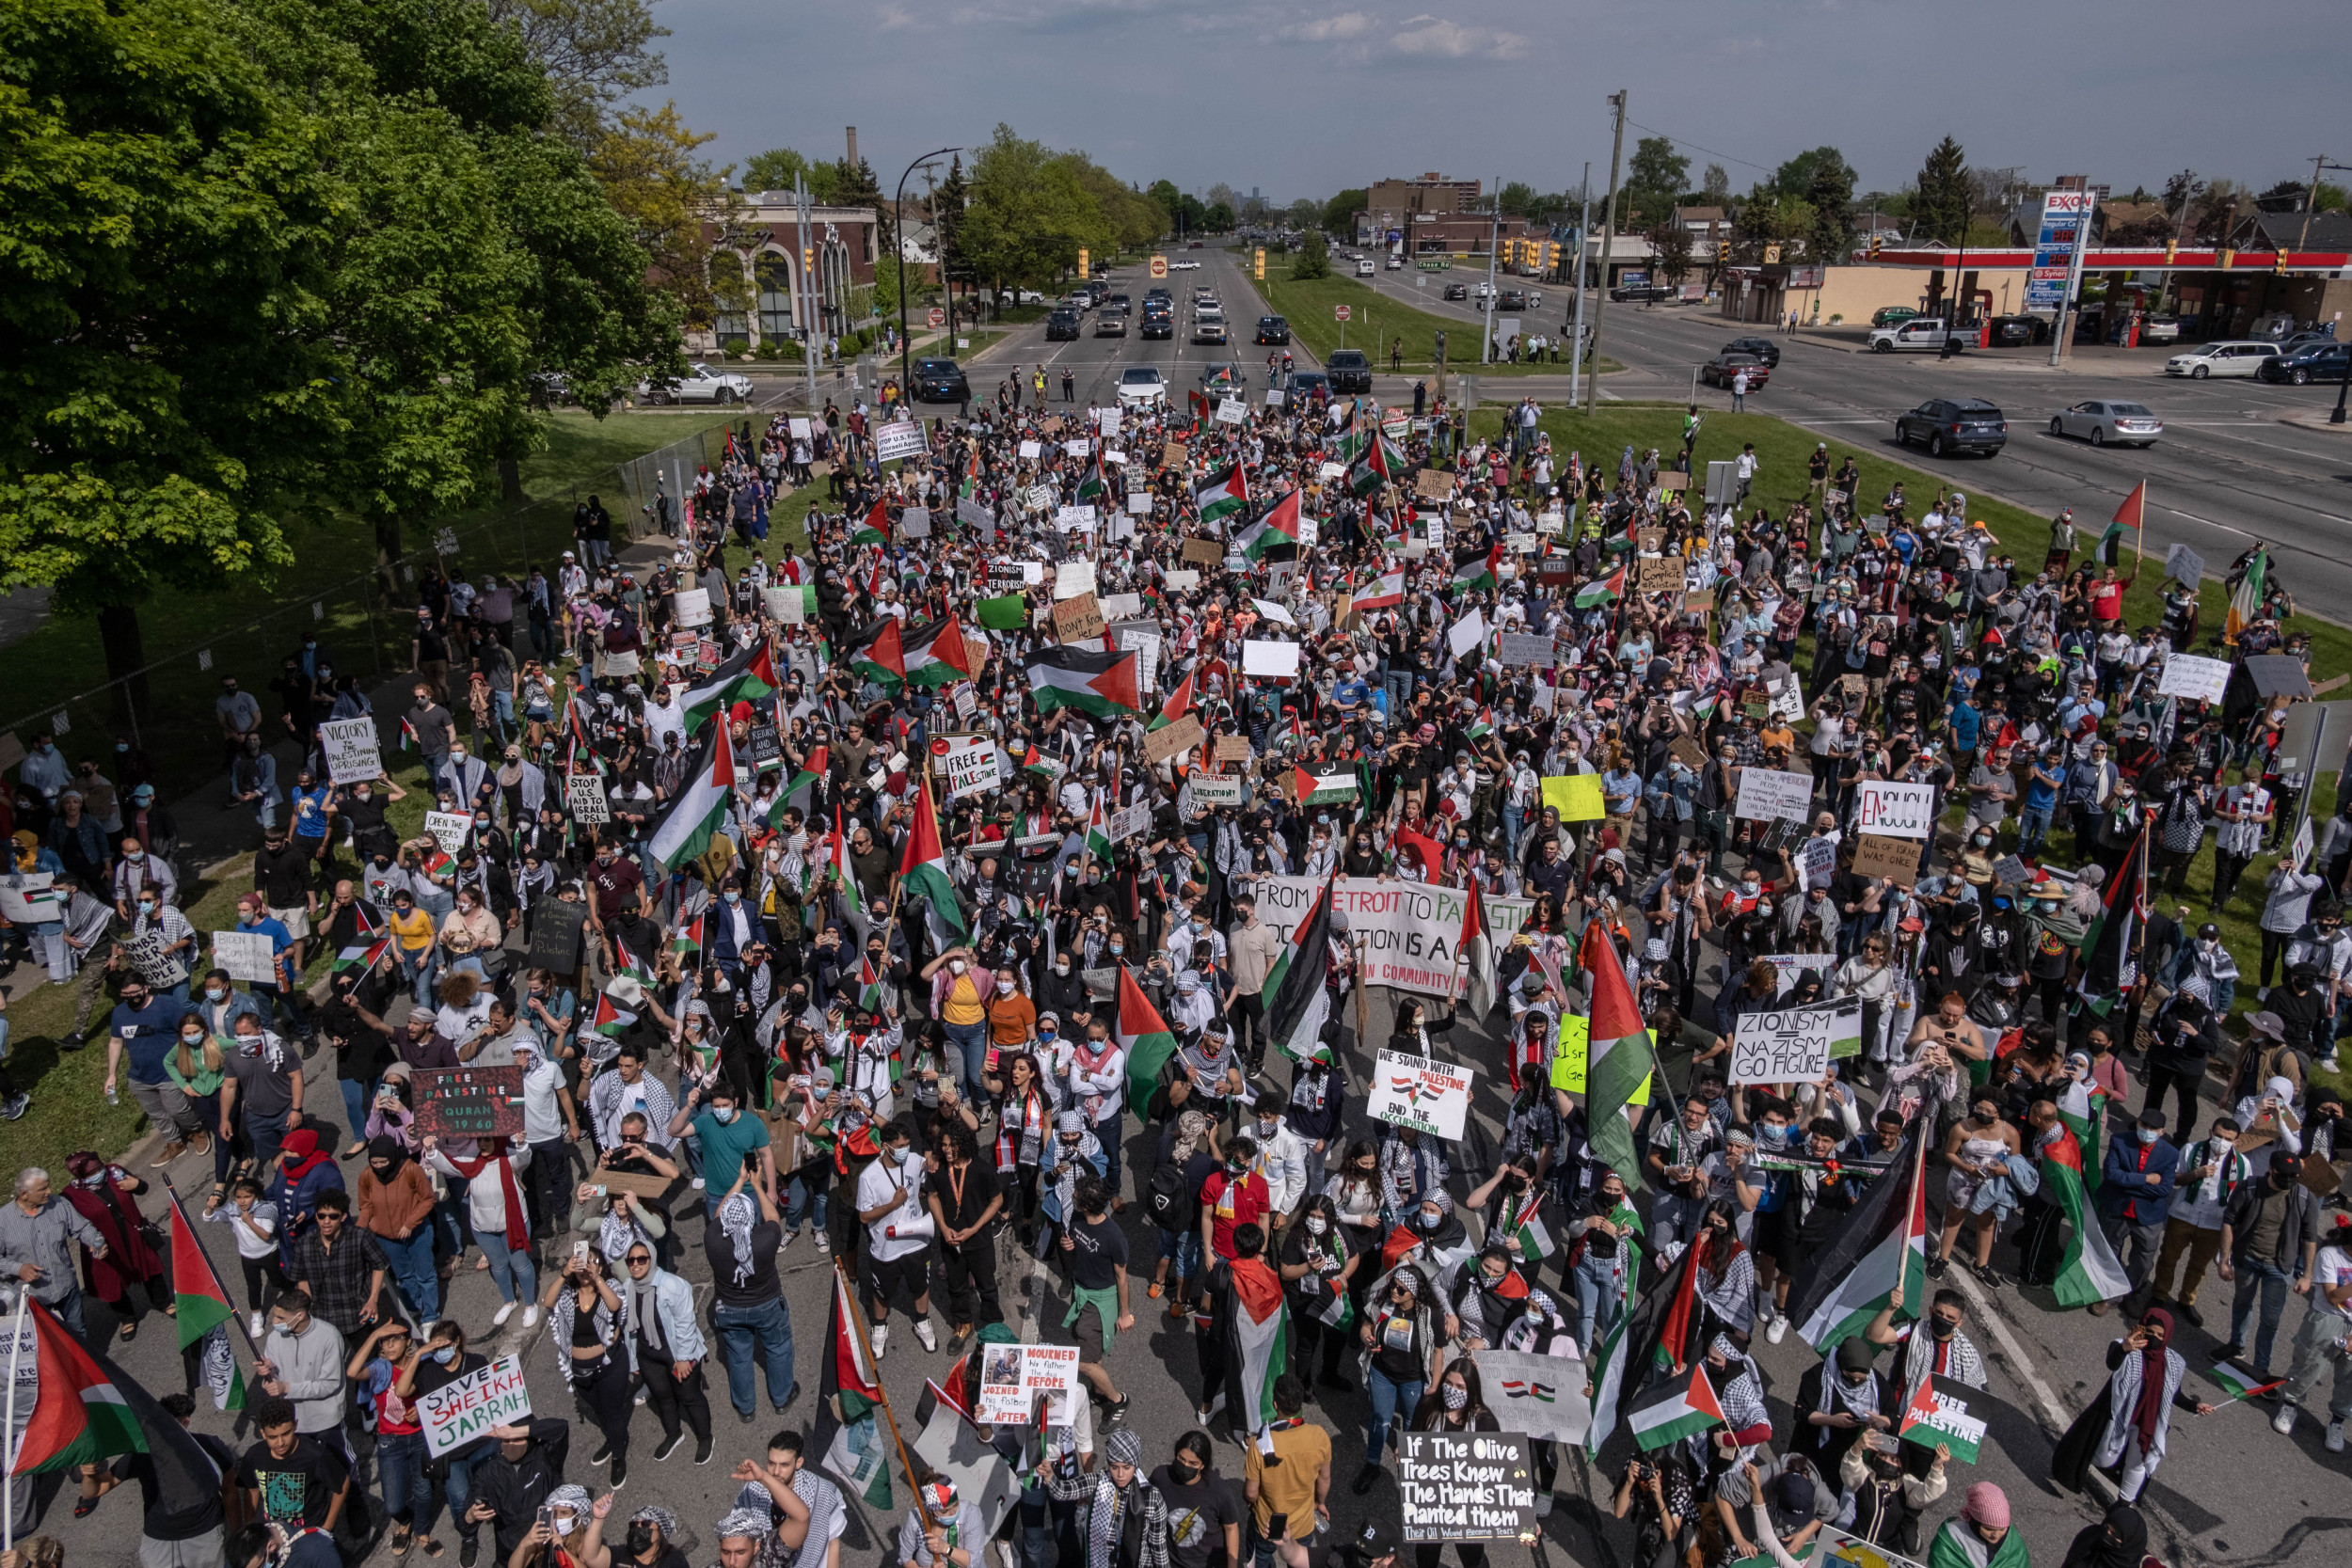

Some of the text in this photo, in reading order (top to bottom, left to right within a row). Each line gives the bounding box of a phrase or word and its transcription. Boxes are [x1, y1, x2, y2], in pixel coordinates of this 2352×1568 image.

[1429, 471, 1443, 480] LONG
[1418, 484, 1451, 497] PALESTINE
[1066, 507, 1088, 516] SAVE
[988, 564, 1023, 575] ZIONISM
[1545, 562, 1565, 571] FREE
[1642, 568, 1680, 581] Complicit
[987, 579, 1025, 590] TERRORISM
[1642, 580, 1680, 590] #Palestine
[773, 591, 791, 600] END
[1059, 617, 1083, 637] DON'T
[1745, 693, 1770, 705] FREE
[325, 722, 368, 741] VICTORY
[752, 726, 776, 740] RETURN
[755, 739, 771, 750] AND
[752, 747, 781, 760] LIBERATE
[949, 751, 977, 773] FREE
[1320, 762, 1337, 776] لن
[951, 768, 997, 791] PALESTINE
[1192, 773, 1233, 782] RESISTANCE
[1748, 770, 1762, 781] We
[1764, 771, 1776, 782] the
[570, 778, 597, 788] STOP
[1759, 781, 1782, 791] PEOPLE
[578, 788, 596, 797] U.S.
[1192, 787, 1236, 799] LIBERATION!
[573, 797, 603, 805] AID TO
[575, 805, 607, 814] ISRAEL
[428, 816, 463, 829] OPEN THE
[1813, 840, 1830, 850] COMES
[1863, 838, 1919, 859] ALL OF ISRAEL
[1815, 848, 1829, 857] WHEN
[1826, 853, 1833, 862] A
[1864, 850, 1911, 868] WAS ONCE
[1255, 881, 1310, 909] FROM
[1405, 891, 1431, 919] TO
[218, 932, 246, 944] BIDEN
[1406, 931, 1449, 960] IS A
[1382, 963, 1451, 990] COMMUNITY
[1740, 1012, 1832, 1034] ZIONISM
[1736, 1037, 1826, 1059] NAZISM
[1378, 1049, 1455, 1076] WE STAND WITH
[1735, 1053, 1826, 1077] GO FIGURE.
[437, 1073, 471, 1085] FREE
[1419, 1070, 1466, 1091] PALESTINE
[426, 1085, 505, 1100] PALESTINE
[445, 1105, 491, 1117] QURAN
[1388, 1101, 1430, 1123] END THE
[1380, 1111, 1439, 1135] OCCUPATION
[1026, 1348, 1075, 1361] MOURNED
[1044, 1360, 1067, 1370] father
[1474, 1352, 1580, 1374] FROM THE RIVER
[1483, 1366, 1501, 1379] TO
[1506, 1368, 1530, 1382] THE
[1026, 1376, 1065, 1388] BEFORE
[426, 1367, 490, 1411] SAVE
[983, 1386, 1019, 1395] JOINED
[432, 1369, 523, 1426] SHEIKH
[985, 1396, 1027, 1407] his father
[1930, 1390, 1968, 1415] FREE
[988, 1404, 1002, 1413] The
[437, 1389, 529, 1448] JARRAH
[994, 1412, 1027, 1422] AFTER
[1547, 1413, 1575, 1430] WILL
[1908, 1406, 1979, 1445] PALESTINE
[1406, 1435, 1519, 1462] If The Olive
[1400, 1458, 1505, 1483] Trees Knew
[1401, 1481, 1534, 1508] The Hands That
[1403, 1502, 1518, 1528] Planted them
[1403, 1526, 1425, 1538] Their
[1426, 1527, 1438, 1537] Oil
[1465, 1528, 1492, 1536] Become
